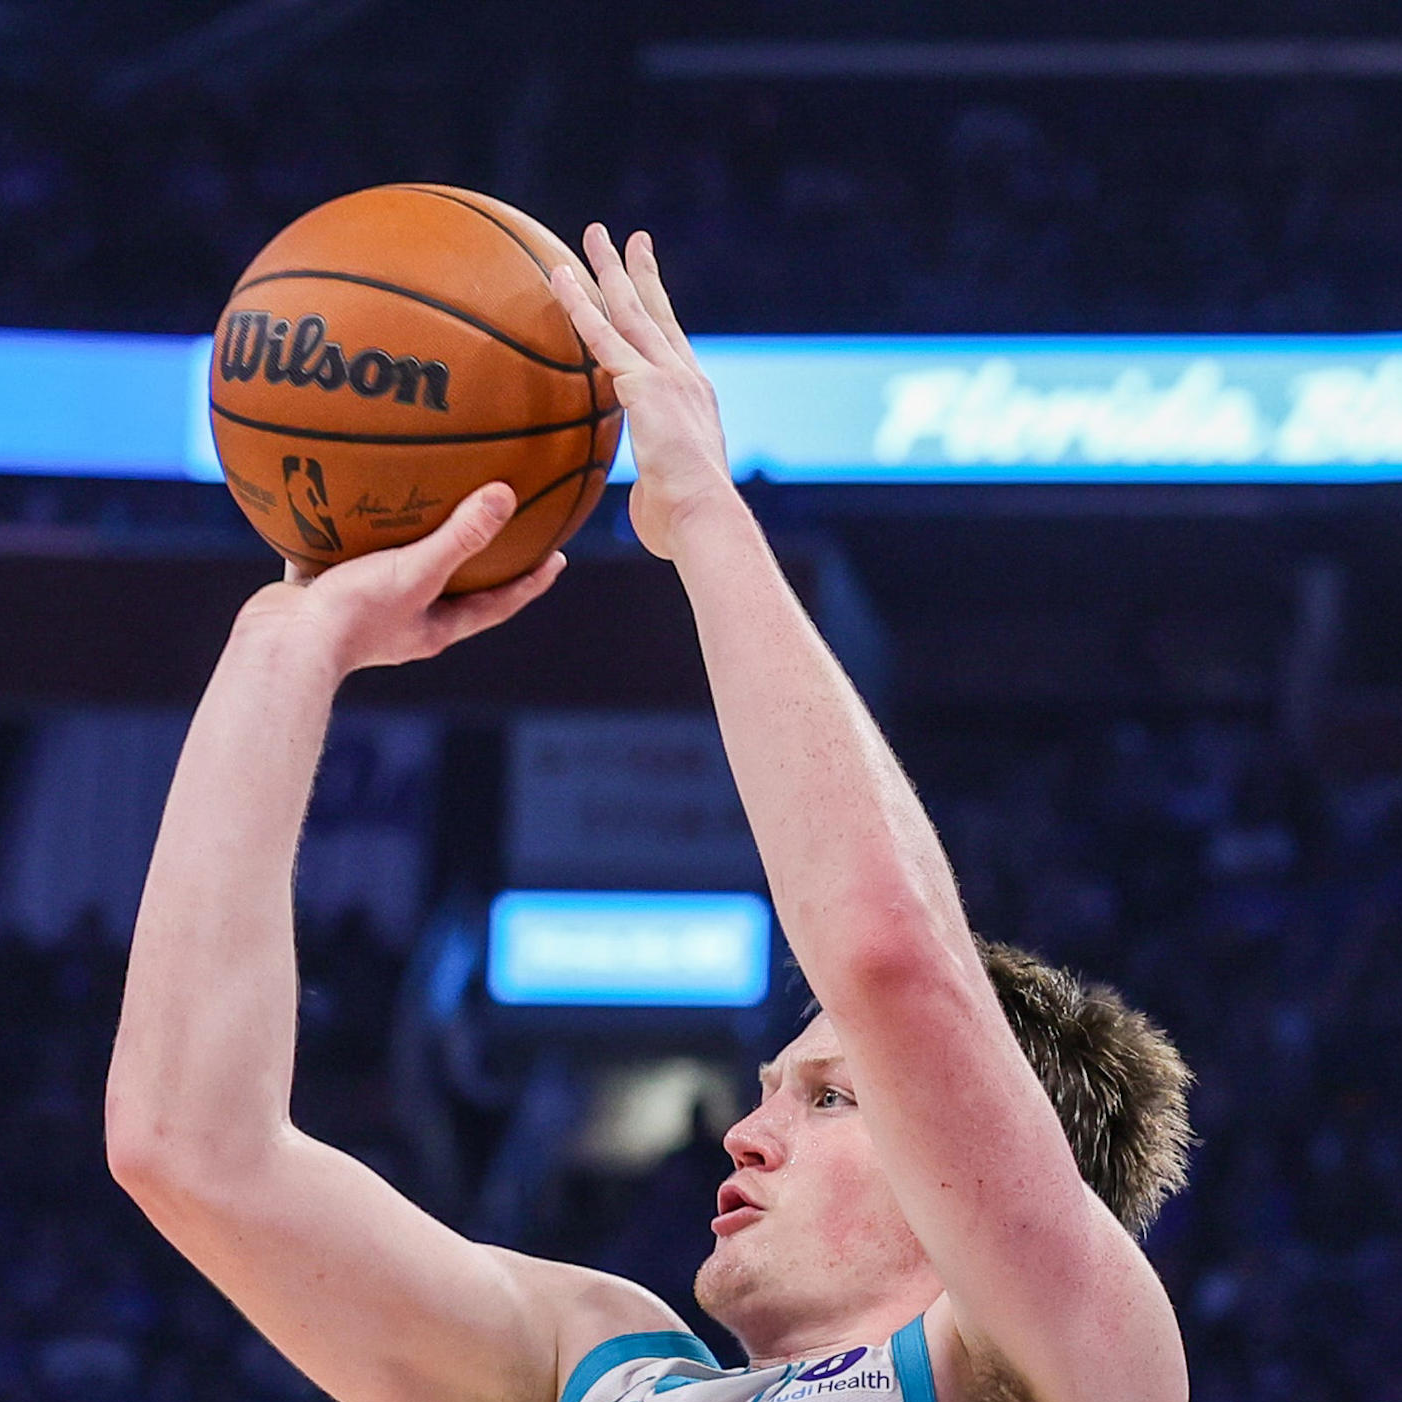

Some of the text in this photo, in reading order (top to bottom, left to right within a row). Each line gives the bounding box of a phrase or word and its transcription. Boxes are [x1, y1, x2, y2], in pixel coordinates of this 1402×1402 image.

[221, 310, 450, 414] Wilson
[874, 356, 1263, 466] Florida
[817, 1370, 890, 1394] Health
